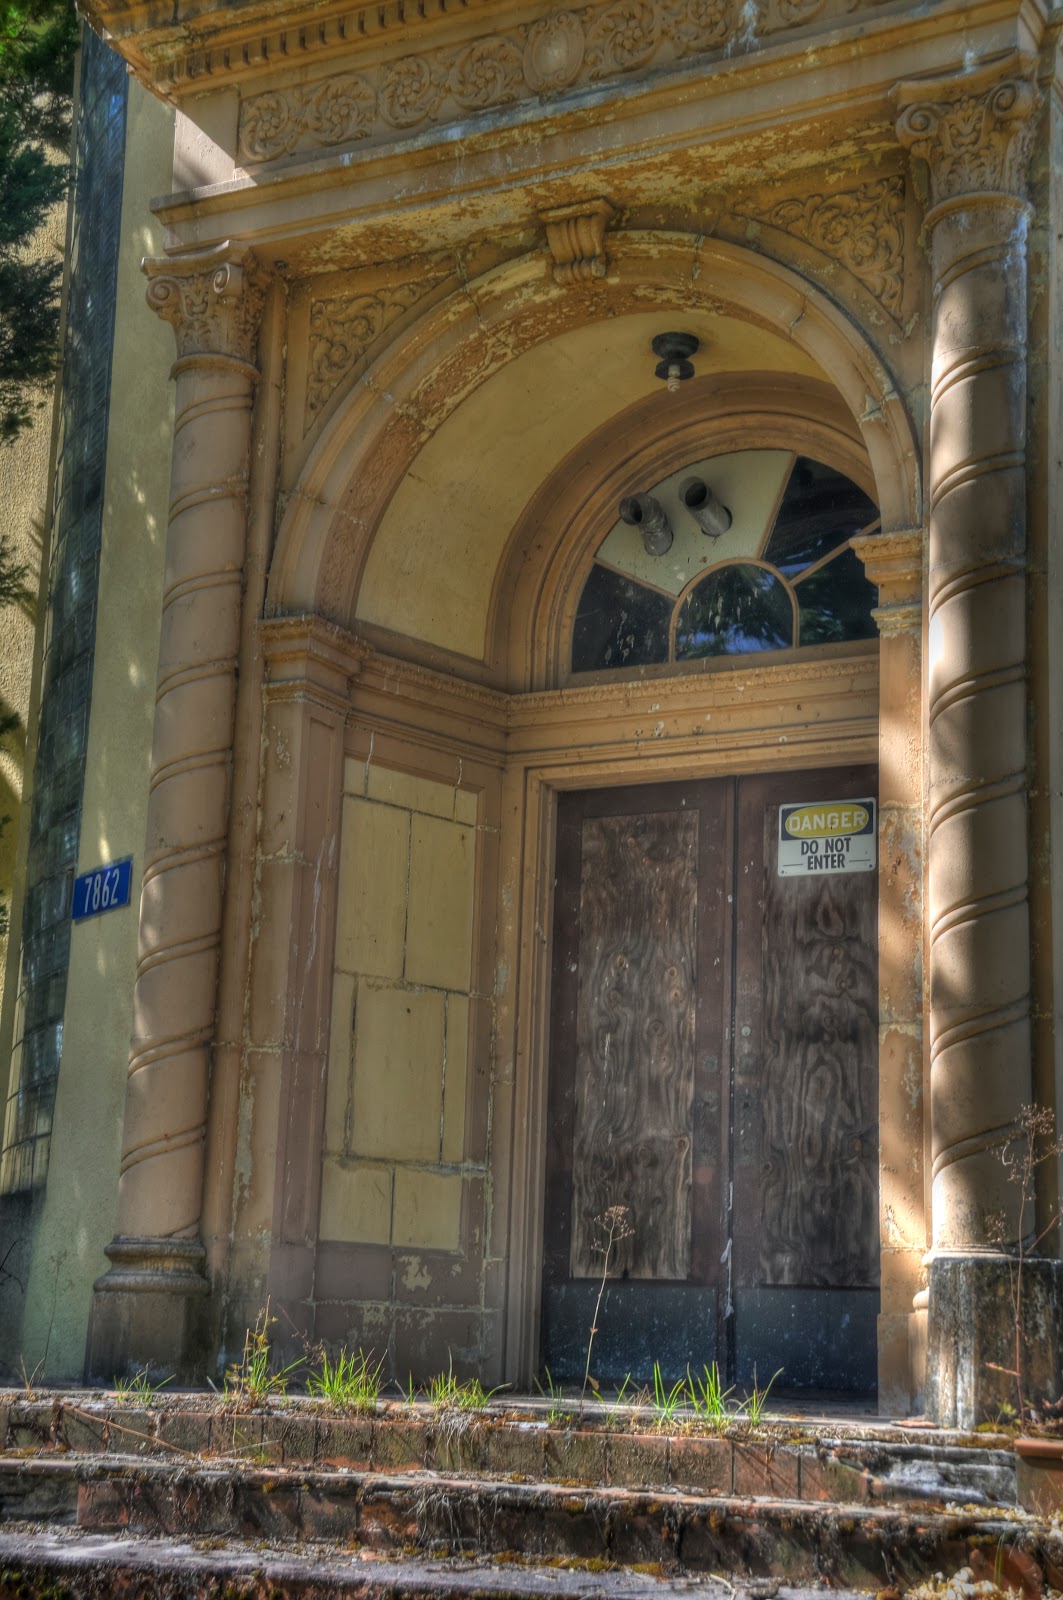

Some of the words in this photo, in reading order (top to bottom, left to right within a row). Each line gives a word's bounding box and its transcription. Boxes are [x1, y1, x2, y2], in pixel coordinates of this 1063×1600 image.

[788, 811, 866, 832] DANGER
[801, 840, 819, 855] DO
[824, 837, 851, 853] NOT
[807, 853, 845, 870] ENTER
[84, 868, 119, 913] 7862
